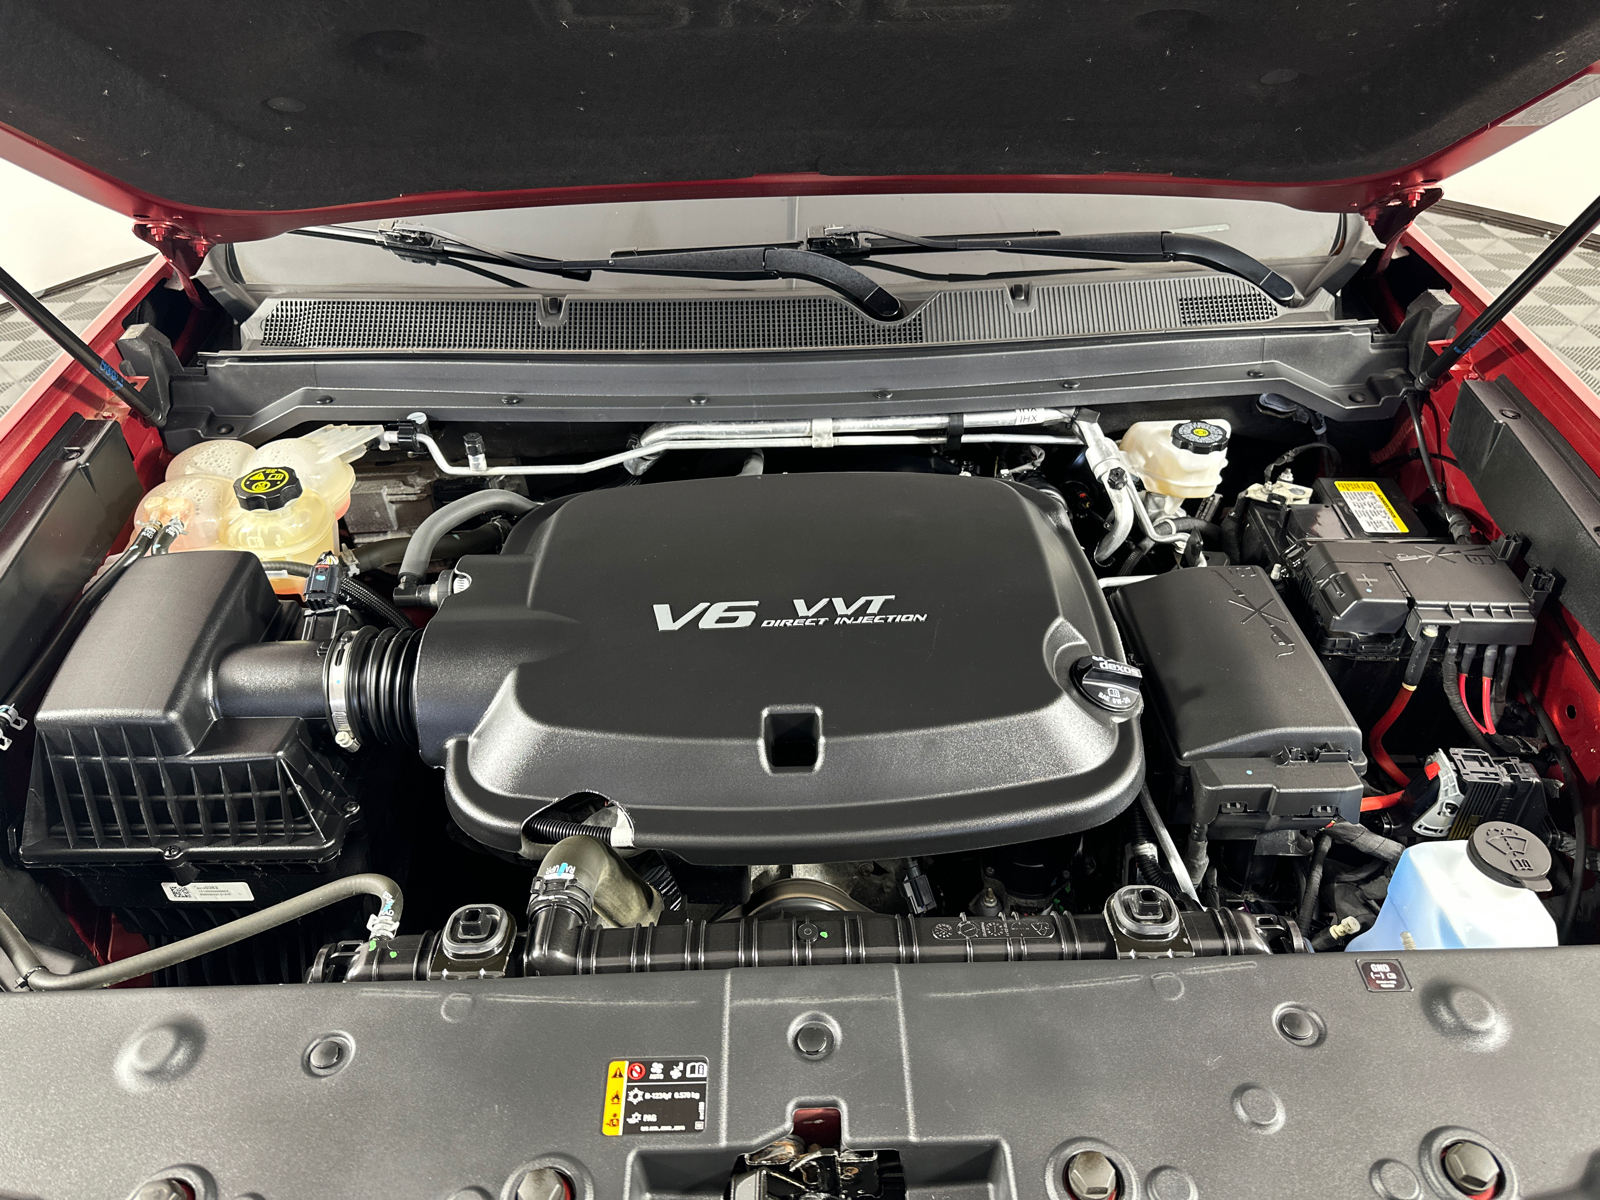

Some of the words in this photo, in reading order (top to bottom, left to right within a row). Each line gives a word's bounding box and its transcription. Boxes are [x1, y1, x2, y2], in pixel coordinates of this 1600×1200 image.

[652, 600, 760, 631] V6
[792, 594, 896, 616] VVT
[760, 617, 830, 628] DIRECT
[833, 613, 928, 626] INJECTION
[1099, 660, 1137, 675] dexos
